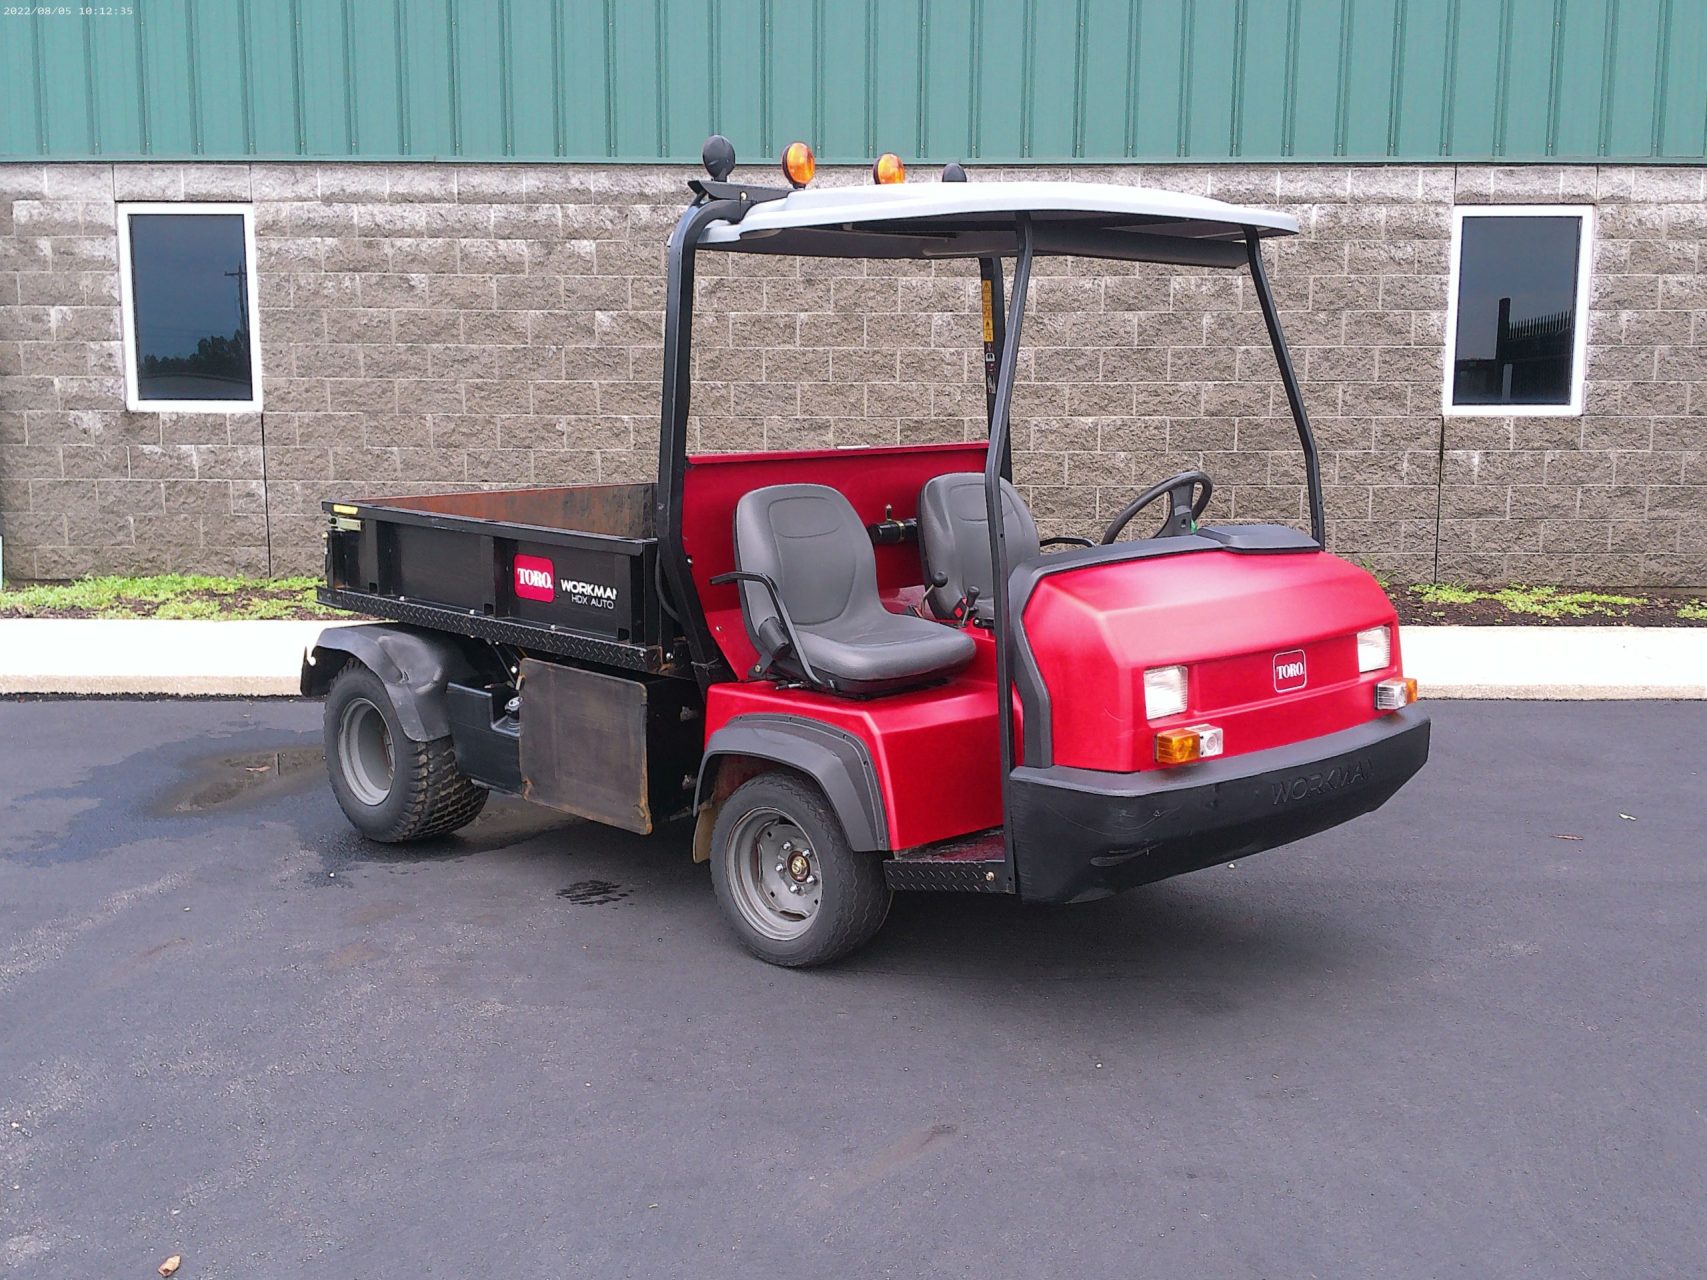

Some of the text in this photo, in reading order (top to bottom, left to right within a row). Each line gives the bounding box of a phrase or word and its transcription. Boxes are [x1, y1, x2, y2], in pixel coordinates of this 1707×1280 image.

[571, 595, 614, 610] HDX AUTO
[1276, 662, 1304, 680] TORO
